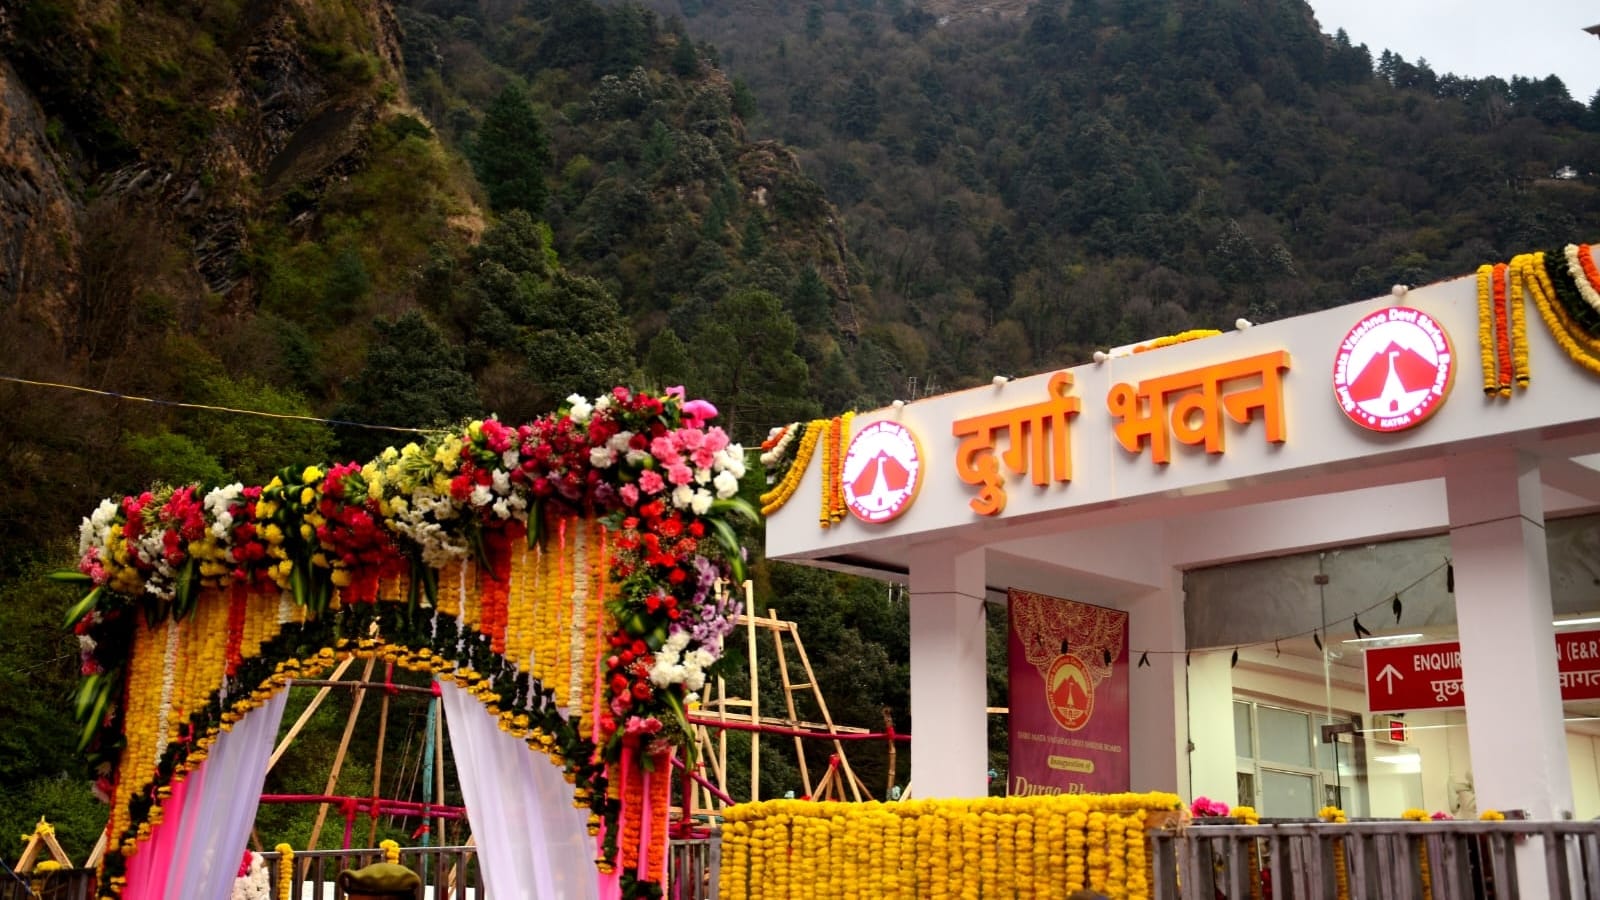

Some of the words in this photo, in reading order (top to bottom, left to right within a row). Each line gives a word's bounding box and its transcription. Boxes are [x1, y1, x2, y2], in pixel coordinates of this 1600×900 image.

[1342, 313, 1387, 351] Vaishno
[1388, 308, 1418, 323] Devi
[952, 371, 1081, 516] दुर्गा
[1107, 350, 1291, 465] भवन
[1380, 415, 1411, 428] KATRA
[1413, 651, 1463, 672] ENQUIR
[1566, 640, 1600, 662] (E&R
[1430, 678, 1464, 702] पूछ
[1559, 669, 1600, 688] वागत
